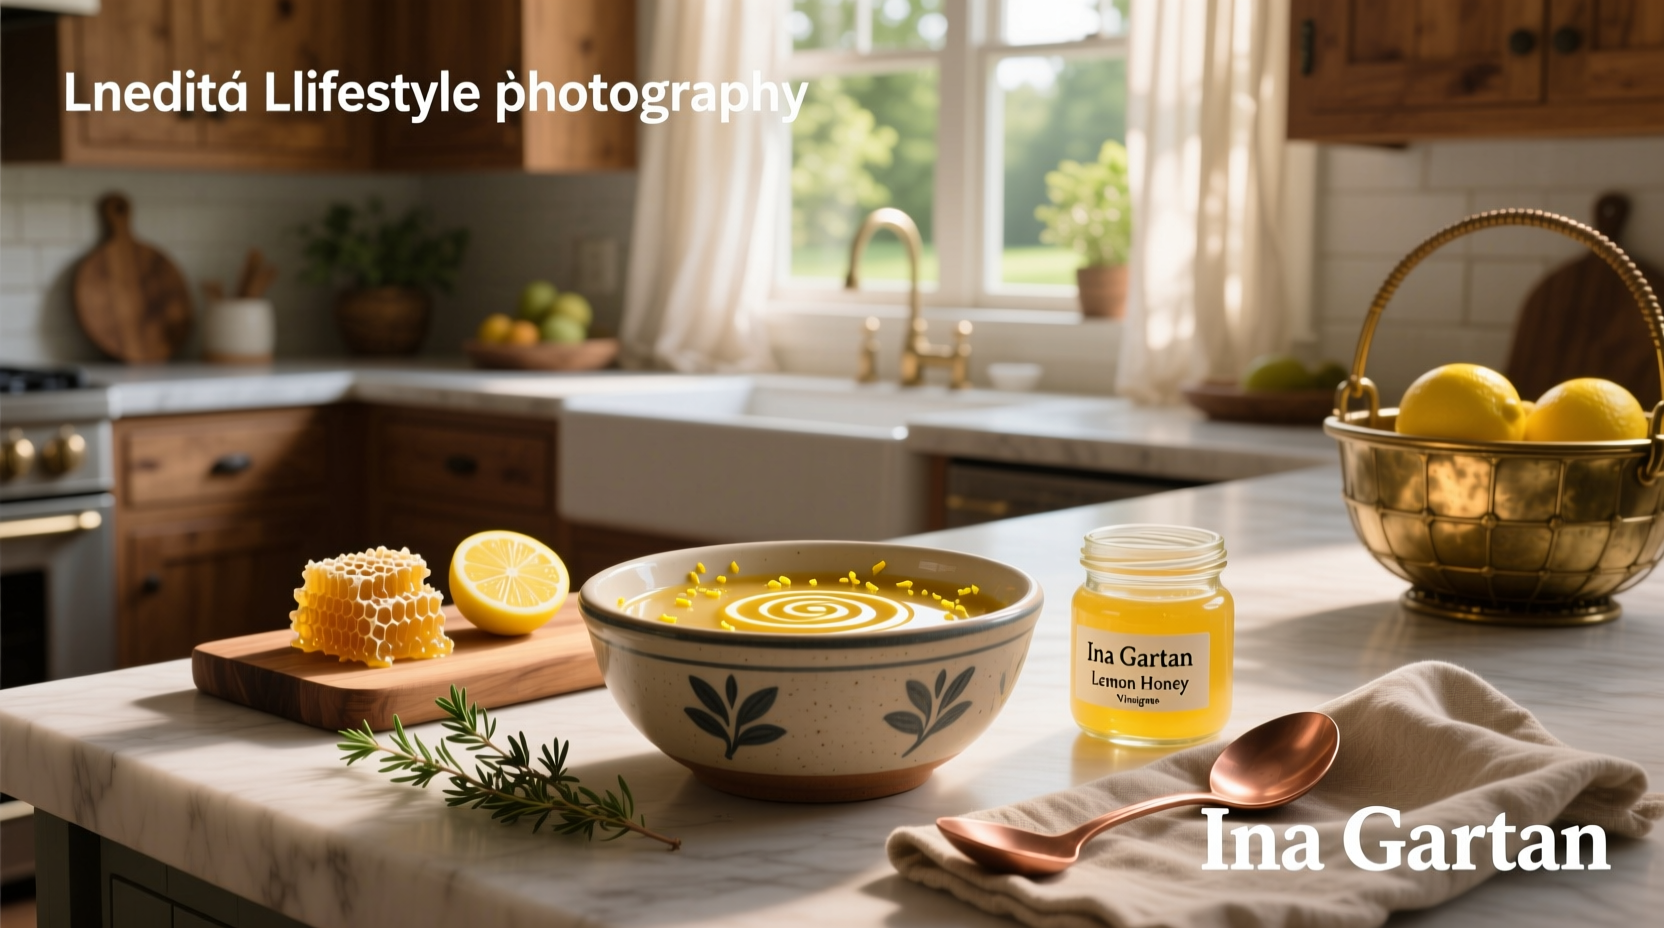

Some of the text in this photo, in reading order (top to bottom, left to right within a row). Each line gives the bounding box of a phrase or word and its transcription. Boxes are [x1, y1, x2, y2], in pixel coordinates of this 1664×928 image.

[1087, 641, 1193, 668] Ina Gartan
[1092, 670, 1190, 696] Lemon Honey
